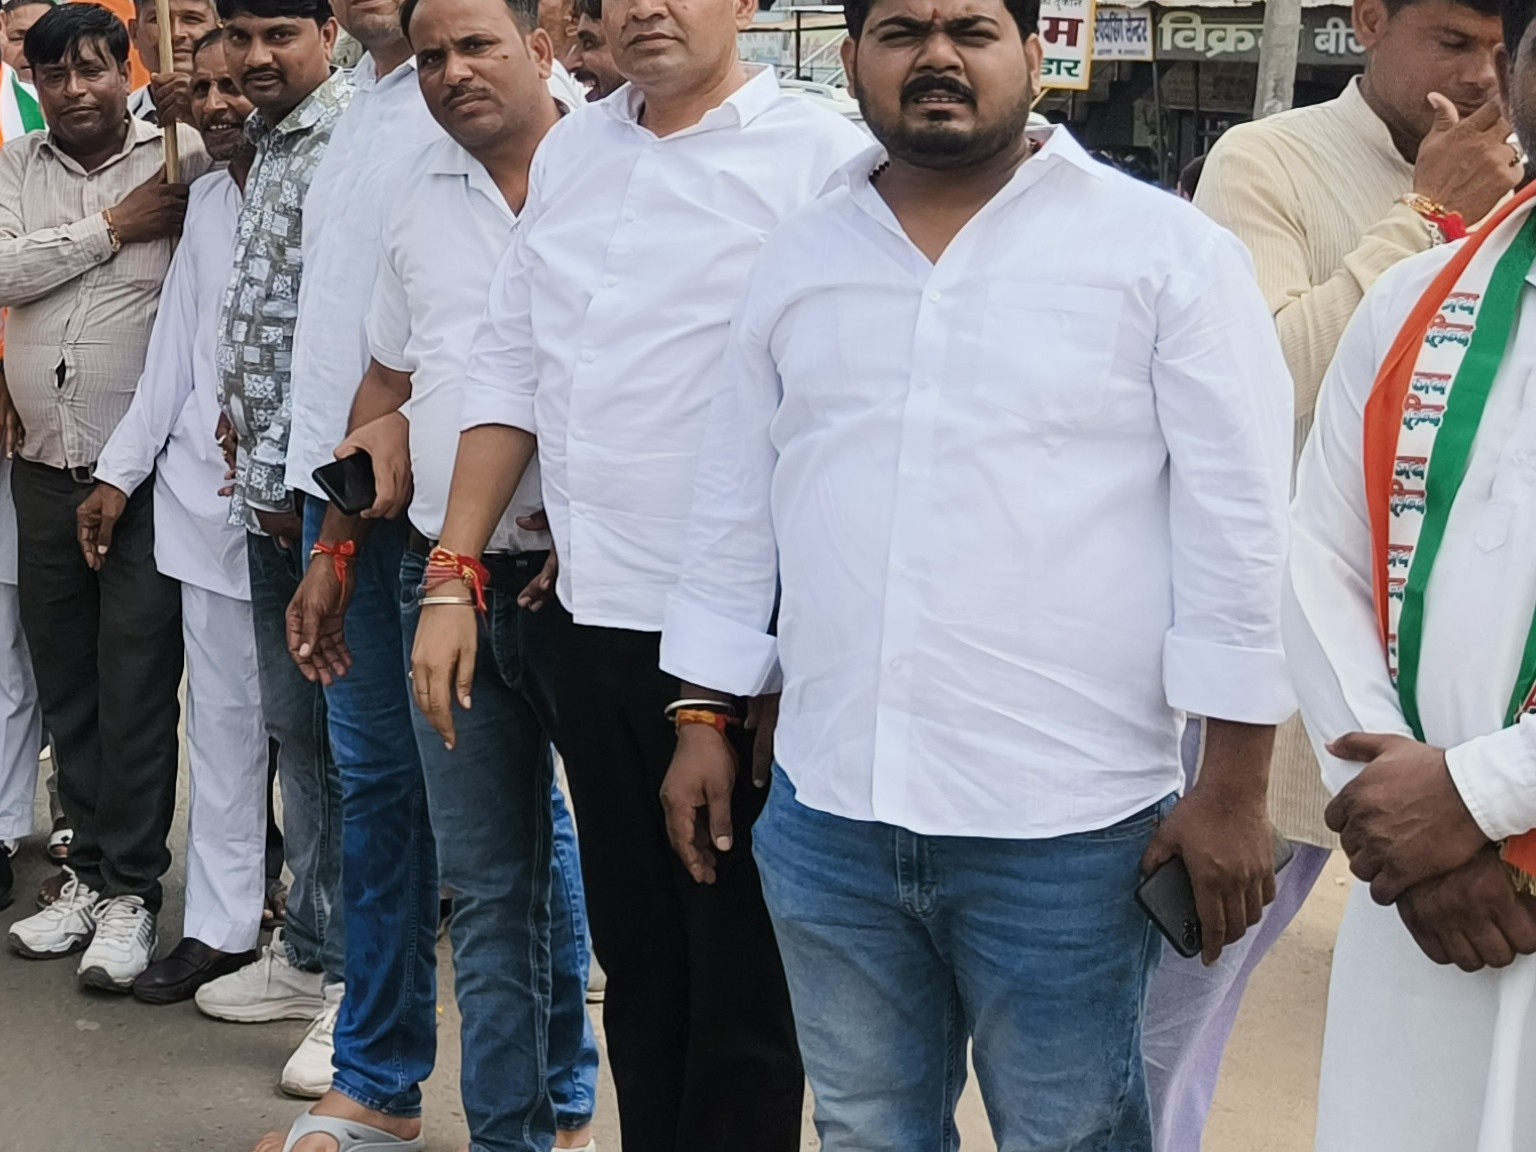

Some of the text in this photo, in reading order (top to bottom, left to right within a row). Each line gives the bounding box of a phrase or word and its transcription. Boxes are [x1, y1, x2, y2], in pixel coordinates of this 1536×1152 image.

[1042, 16, 1084, 48] म
[1158, 11, 1304, 59] विक्र
[1041, 57, 1082, 78] डार
